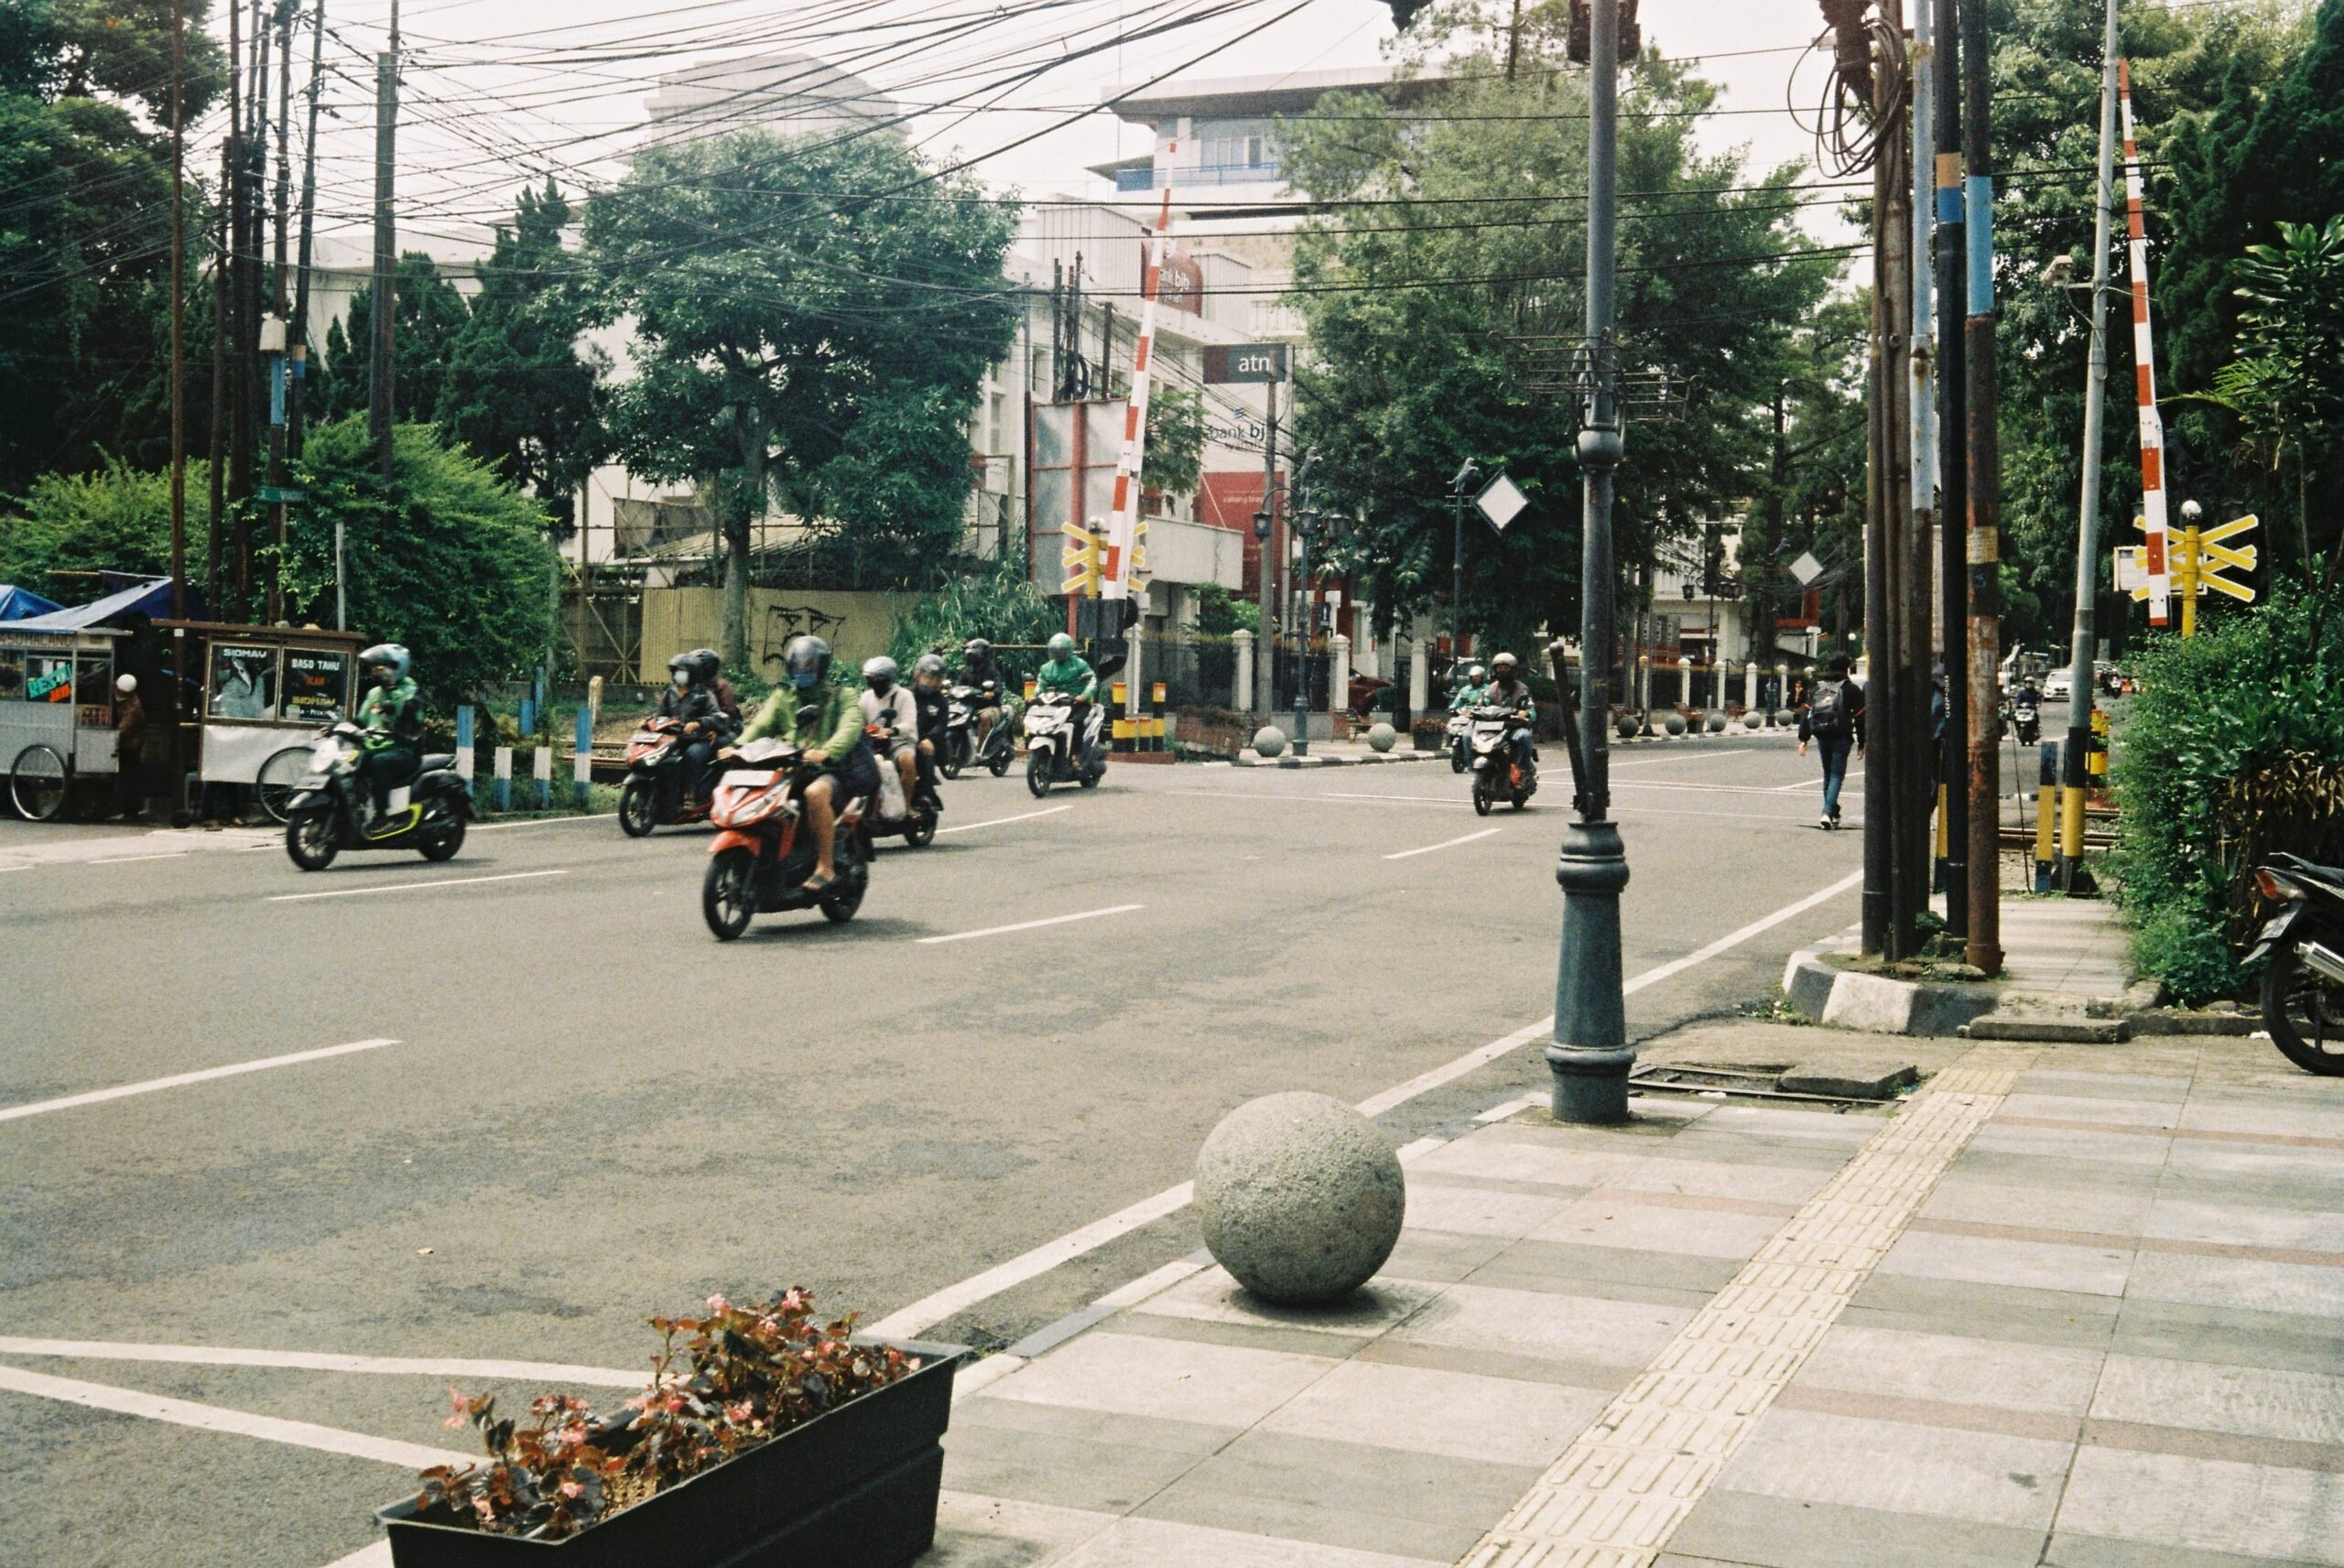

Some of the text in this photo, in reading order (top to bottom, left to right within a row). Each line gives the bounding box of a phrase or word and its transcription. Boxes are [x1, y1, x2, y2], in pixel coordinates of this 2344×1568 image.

[1250, 423, 1265, 441] bj
[291, 658, 341, 671] BASO TAHU
